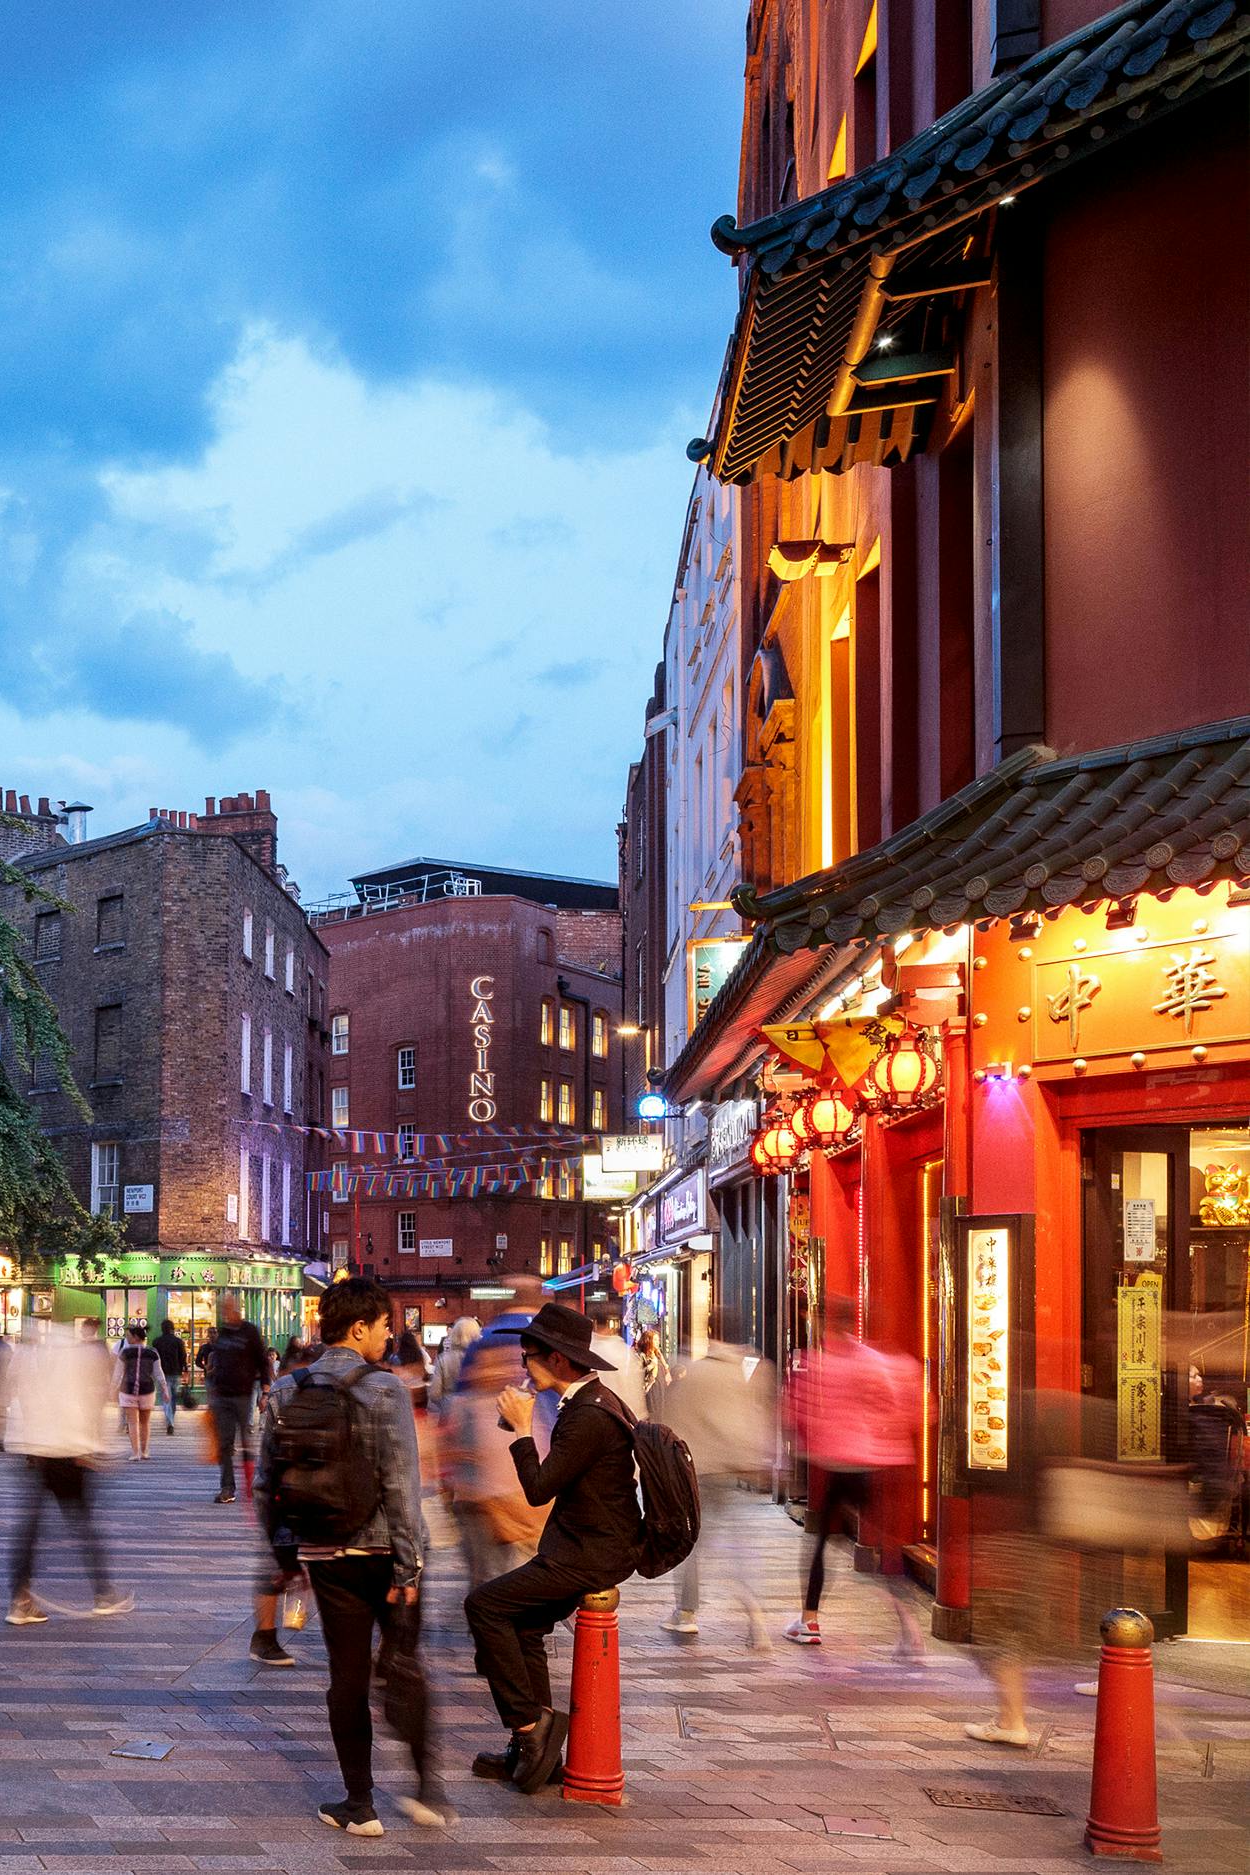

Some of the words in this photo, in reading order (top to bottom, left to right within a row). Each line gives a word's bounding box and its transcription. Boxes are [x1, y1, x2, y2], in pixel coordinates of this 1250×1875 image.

[469, 976, 497, 1122] CASINO
[1046, 947, 1229, 1052] 中華
[1141, 1280, 1159, 1288] OPEN
